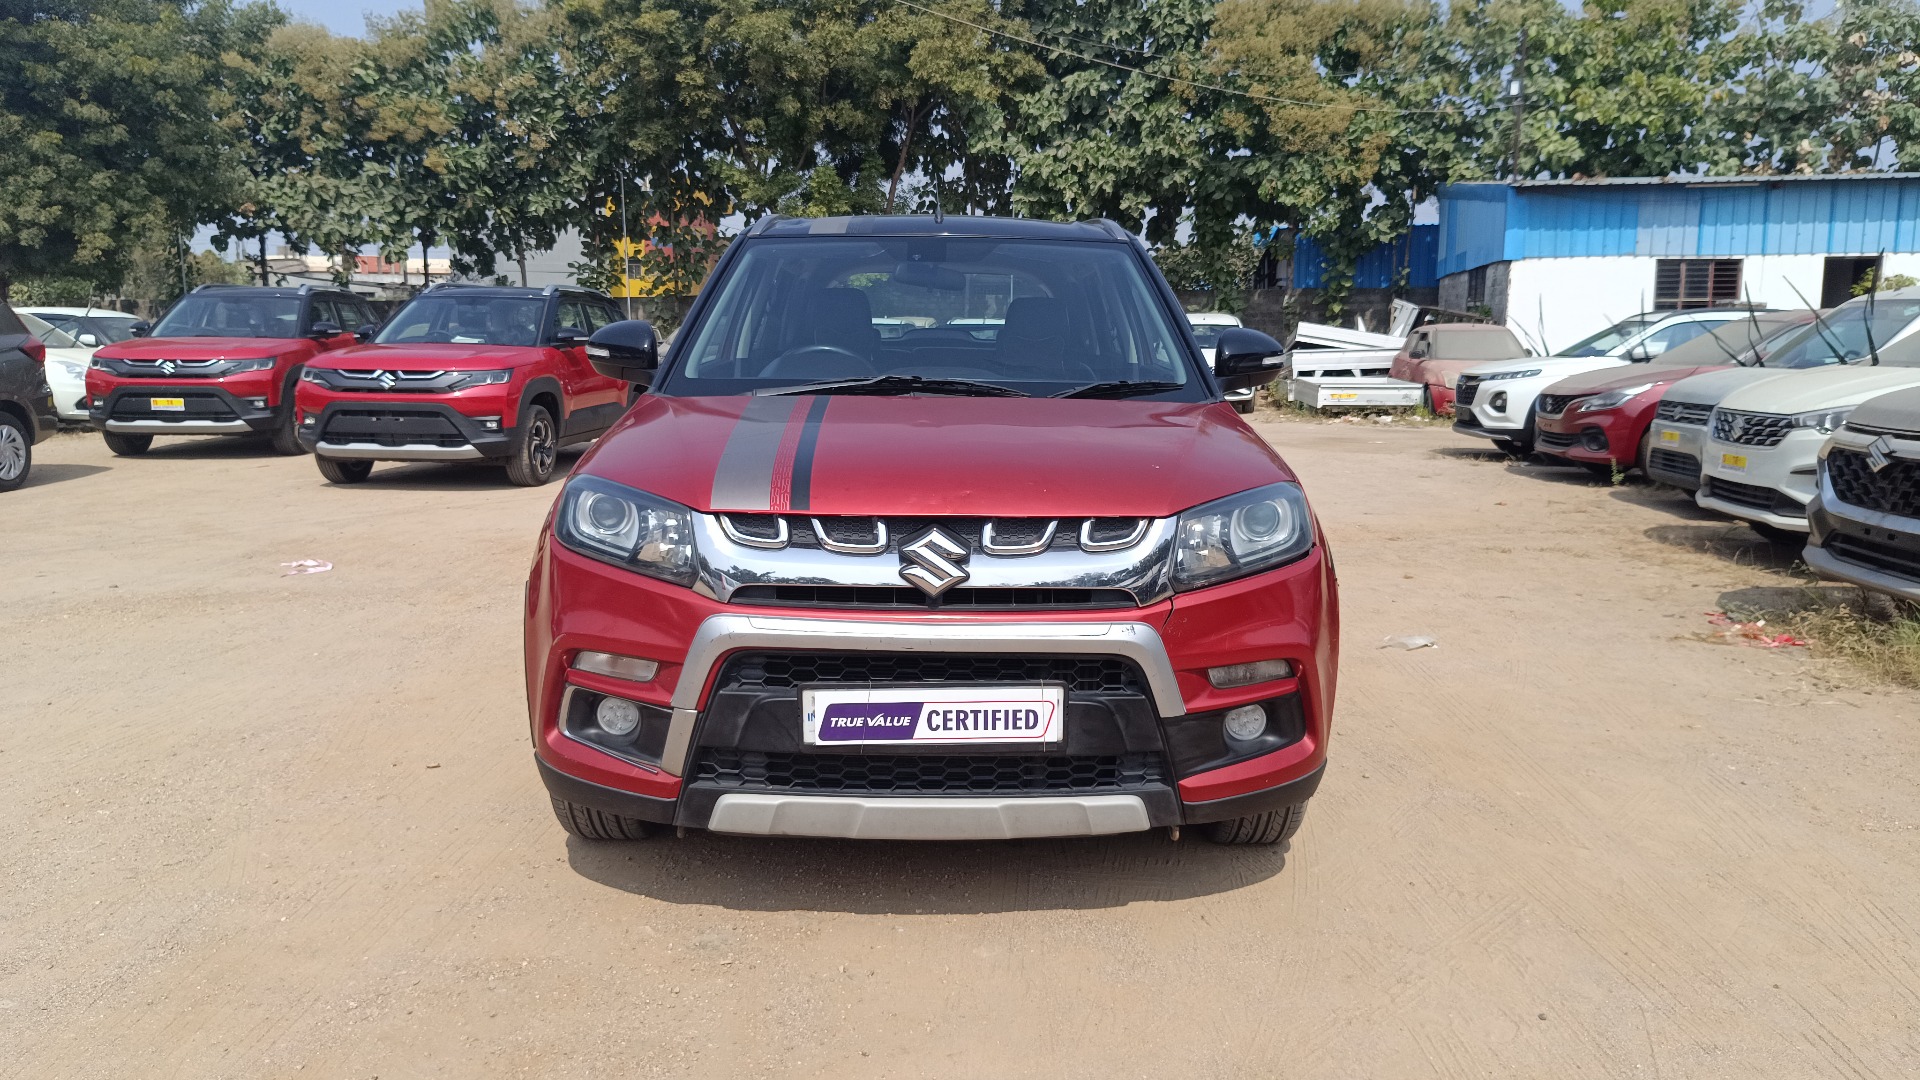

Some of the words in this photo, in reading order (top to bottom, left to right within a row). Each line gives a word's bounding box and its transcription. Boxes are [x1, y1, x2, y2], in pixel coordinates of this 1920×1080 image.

[830, 716, 865, 728] TRUE
[866, 712, 912, 727] VALUE
[926, 708, 1039, 732] CERTIFIED
